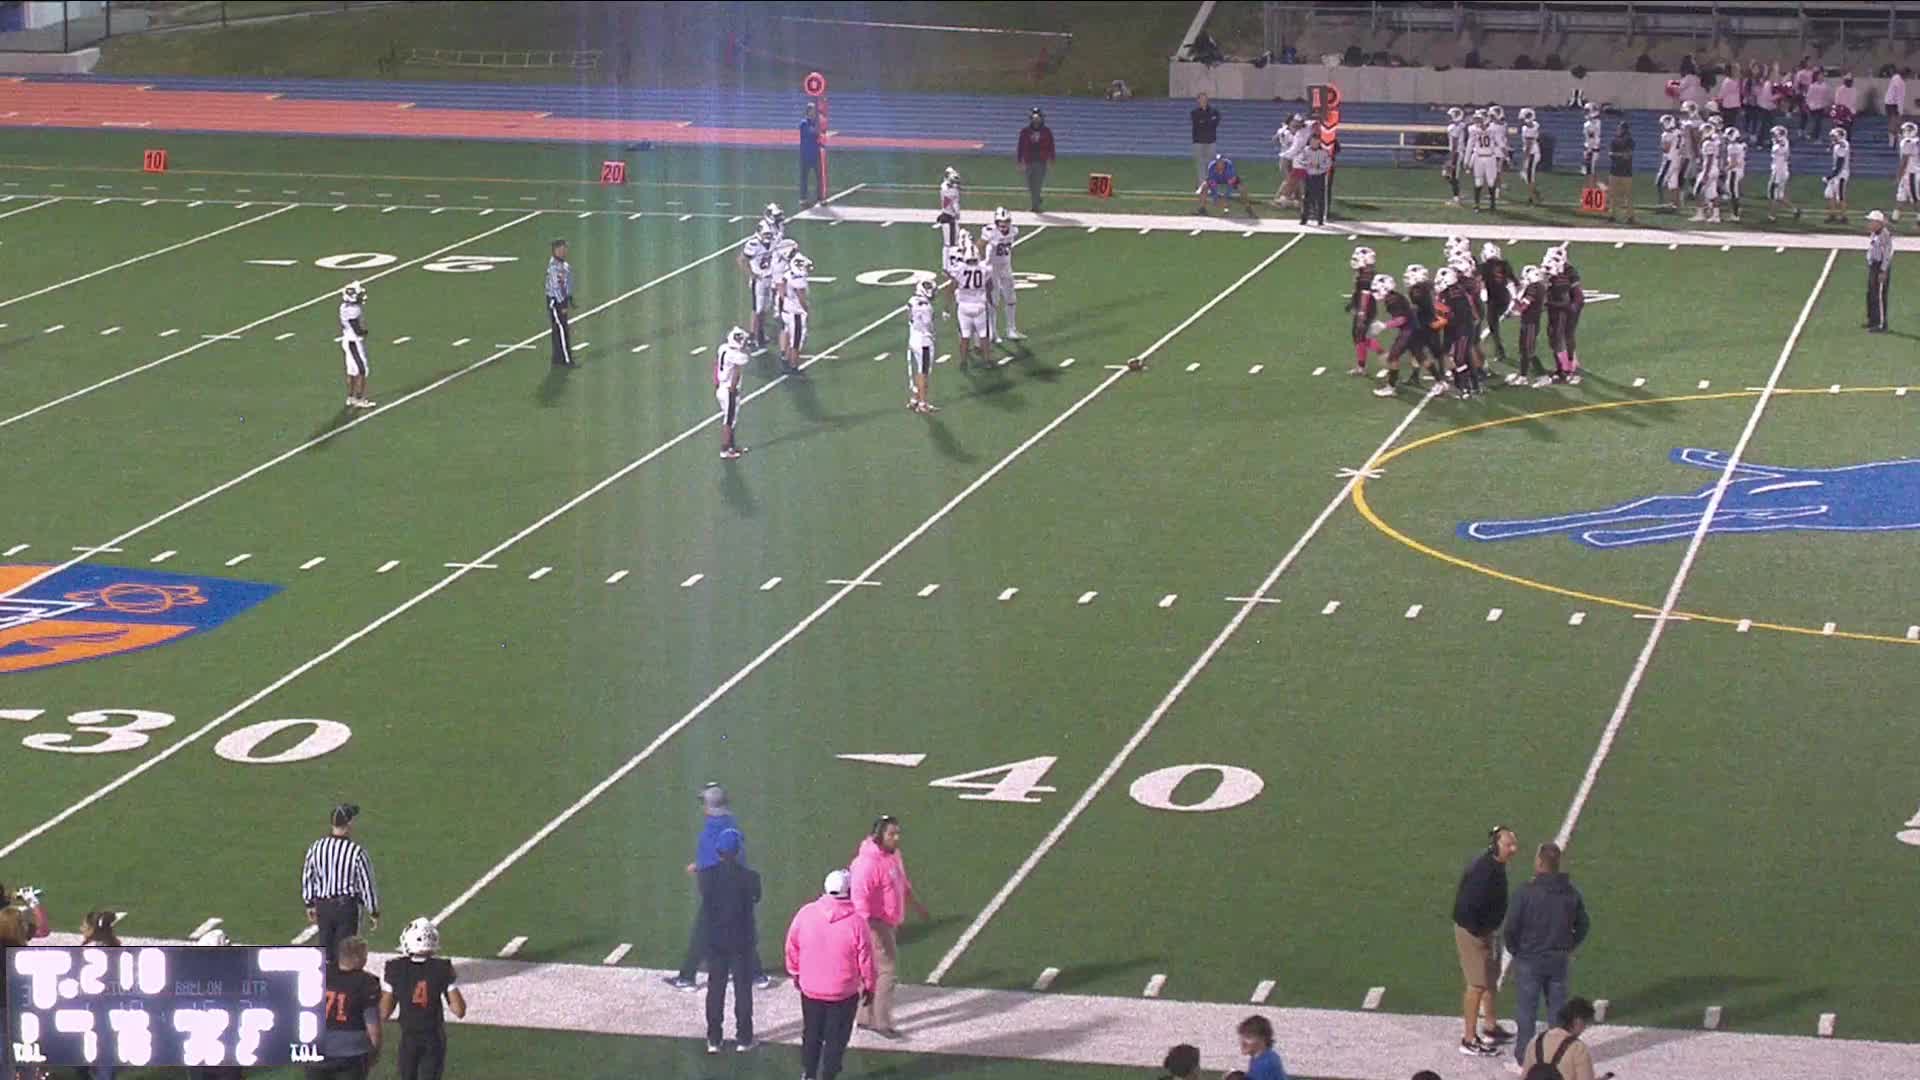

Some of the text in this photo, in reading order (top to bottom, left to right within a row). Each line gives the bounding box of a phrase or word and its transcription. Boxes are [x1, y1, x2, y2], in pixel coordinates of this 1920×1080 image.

[146, 151, 162, 169] 10
[603, 164, 622, 182] 20
[1584, 190, 1603, 208] 40
[963, 270, 983, 289] 70
[412, 978, 429, 1009] 4
